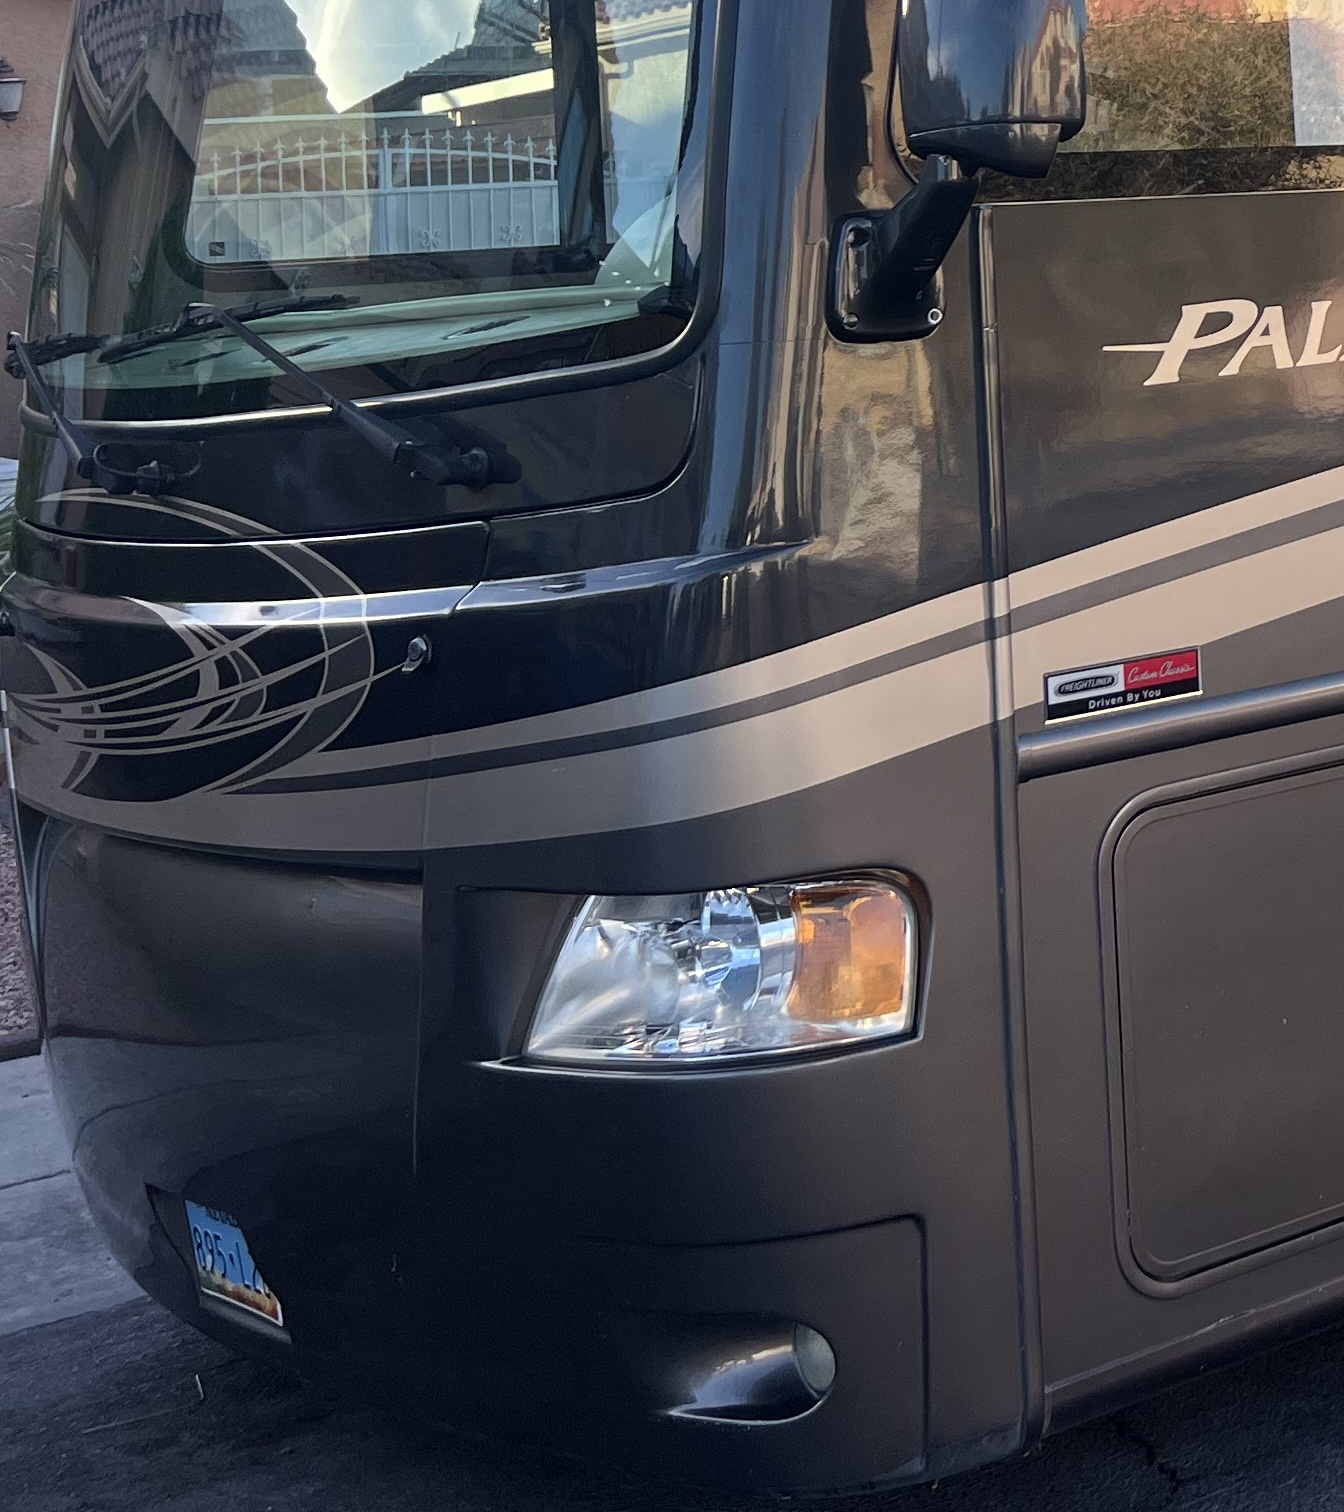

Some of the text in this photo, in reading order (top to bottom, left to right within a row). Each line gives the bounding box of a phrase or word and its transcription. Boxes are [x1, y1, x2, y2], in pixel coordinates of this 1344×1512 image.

[1127, 660, 1195, 683] Custom Chassis
[1060, 675, 1113, 693] FREIGHTLINER
[1088, 688, 1161, 709] Driven By You
